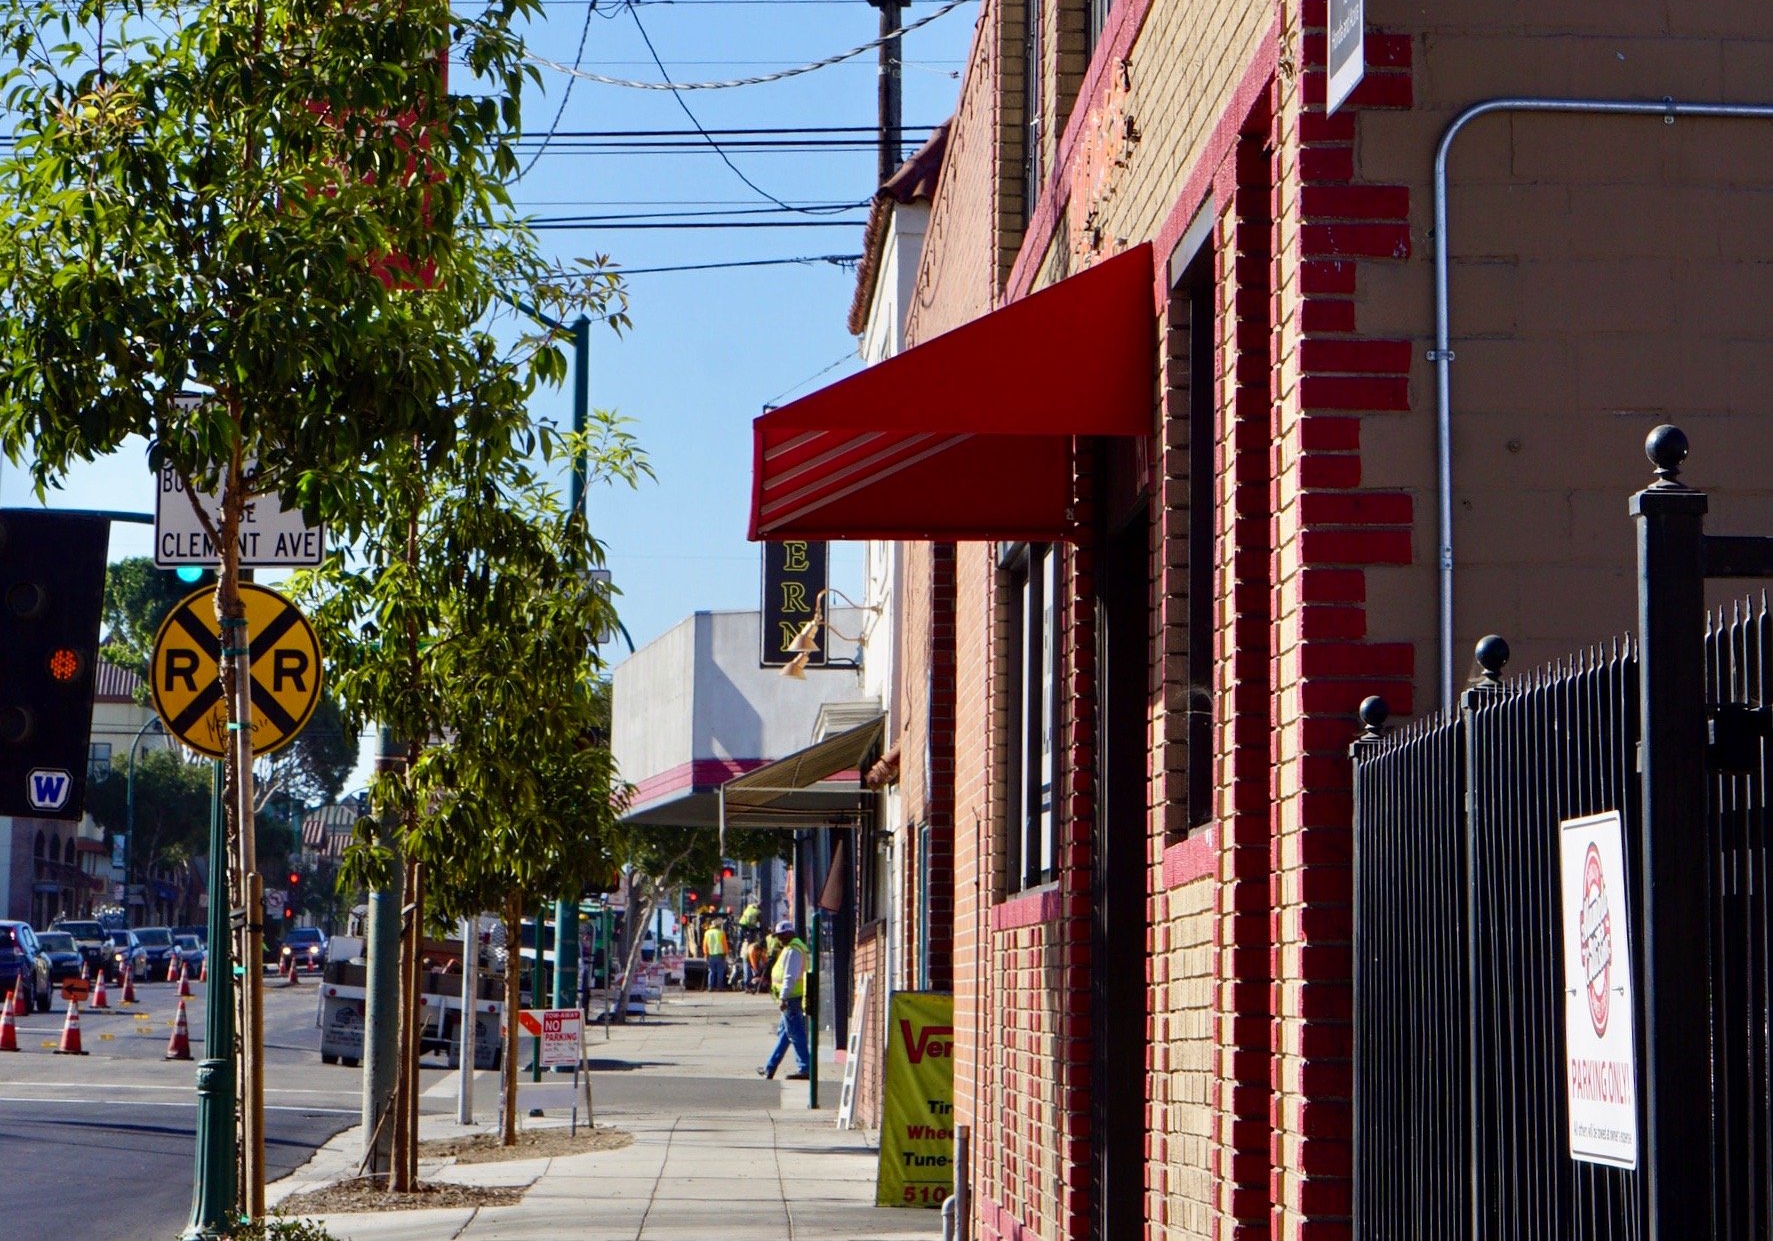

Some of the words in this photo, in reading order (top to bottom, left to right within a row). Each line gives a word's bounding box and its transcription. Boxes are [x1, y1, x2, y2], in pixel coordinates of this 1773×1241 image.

[162, 532, 260, 558] CLEMNT
[275, 532, 315, 558] AVE
[165, 649, 200, 692] R
[273, 650, 308, 693] R
[34, 775, 65, 805] W
[545, 1020, 560, 1032] NO
[545, 1033, 577, 1042] PARKING
[1571, 1058, 1607, 1103] PARKING
[1608, 1062, 1631, 1105] ONLY!
